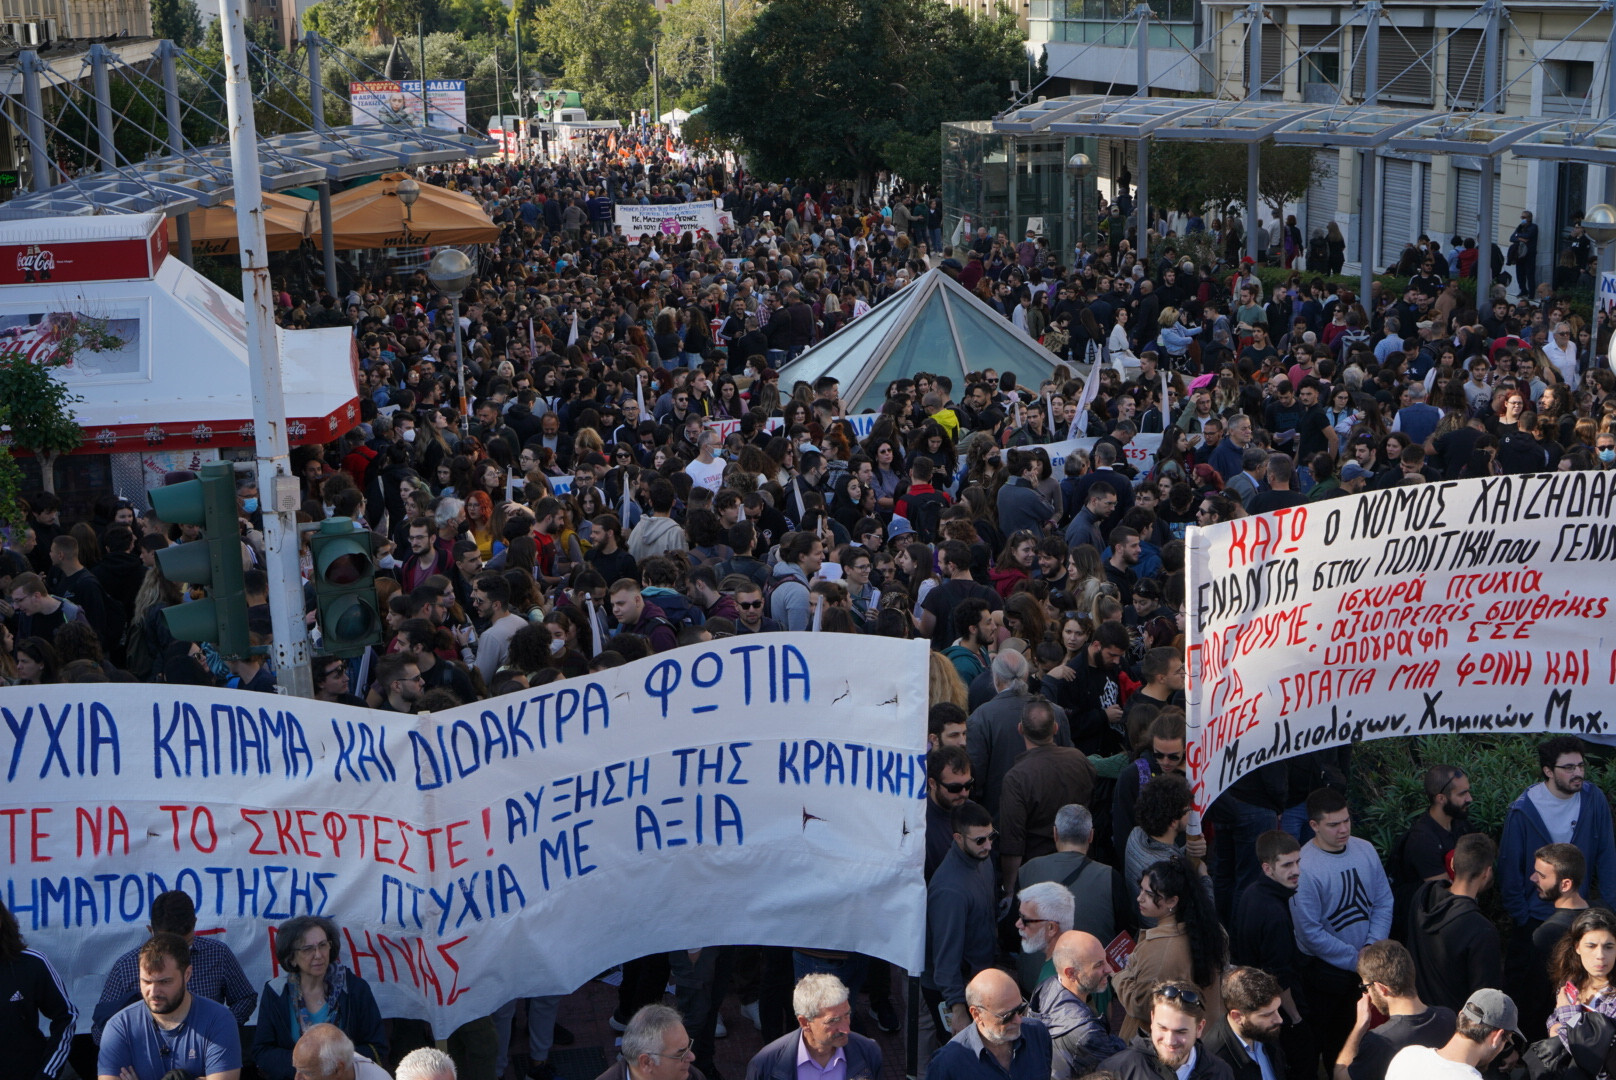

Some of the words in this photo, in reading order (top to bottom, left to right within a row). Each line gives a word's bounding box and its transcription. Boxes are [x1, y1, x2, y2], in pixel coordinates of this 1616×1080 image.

[1228, 507, 1308, 568] ΚΑΤΩ
[1324, 509, 1341, 546] Ο
[1351, 482, 1458, 540] ΝΟΜΟΣ
[1198, 557, 1299, 632] ΕΝΑΝΤΙΑ
[1375, 529, 1496, 577] ΠΟΛΙΤΙΚΗ
[1488, 538, 1540, 566] που
[1337, 573, 1427, 613] ισχυρά
[1446, 565, 1543, 600] πτυχία
[154, 701, 312, 779] ΚΑΠΑΜΑ
[332, 718, 396, 783] ΚΑΙ
[645, 644, 811, 717] ΦΩΤΙΑ
[1210, 668, 1244, 716] ΓΙΑ
[1279, 668, 1376, 716] ΕΡΓΑΤΙΑ
[1388, 659, 1441, 691] ΜΙΑ
[1544, 649, 1589, 686] ΚΑΙ
[76, 806, 129, 858] ΝΑ
[159, 805, 218, 854] ΤΟ
[505, 757, 650, 844] ΑΥΞΗΣΗ
[671, 742, 752, 786] ΤΗΣ
[779, 739, 927, 799] ΚΡΑΤΙΚΗΣ
[381, 863, 526, 936] ΠΤΥΧΙΑ
[539, 819, 597, 891] ΜΕ
[635, 793, 744, 852] ΑΞΙΑ
